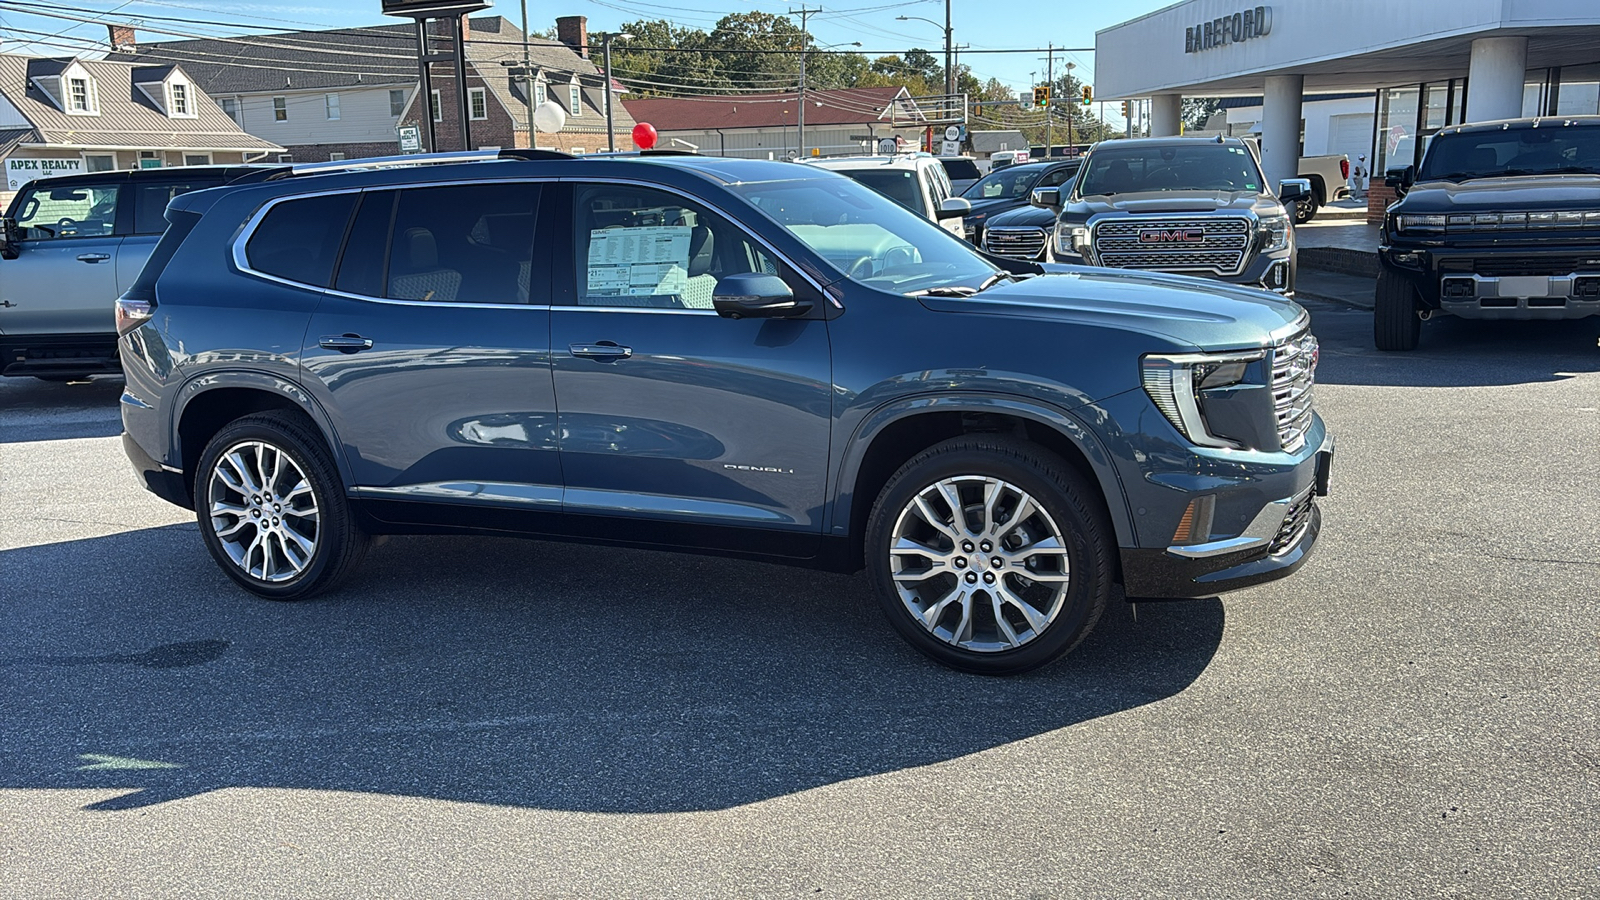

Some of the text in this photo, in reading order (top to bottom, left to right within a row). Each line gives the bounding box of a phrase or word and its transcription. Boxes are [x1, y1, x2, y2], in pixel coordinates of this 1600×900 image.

[1185, 6, 1272, 53] BAREFORD
[880, 144, 894, 152] 1010
[10, 160, 80, 170] APEX REALTY
[1140, 230, 1202, 242] GMC
[724, 464, 794, 474] DENALI
